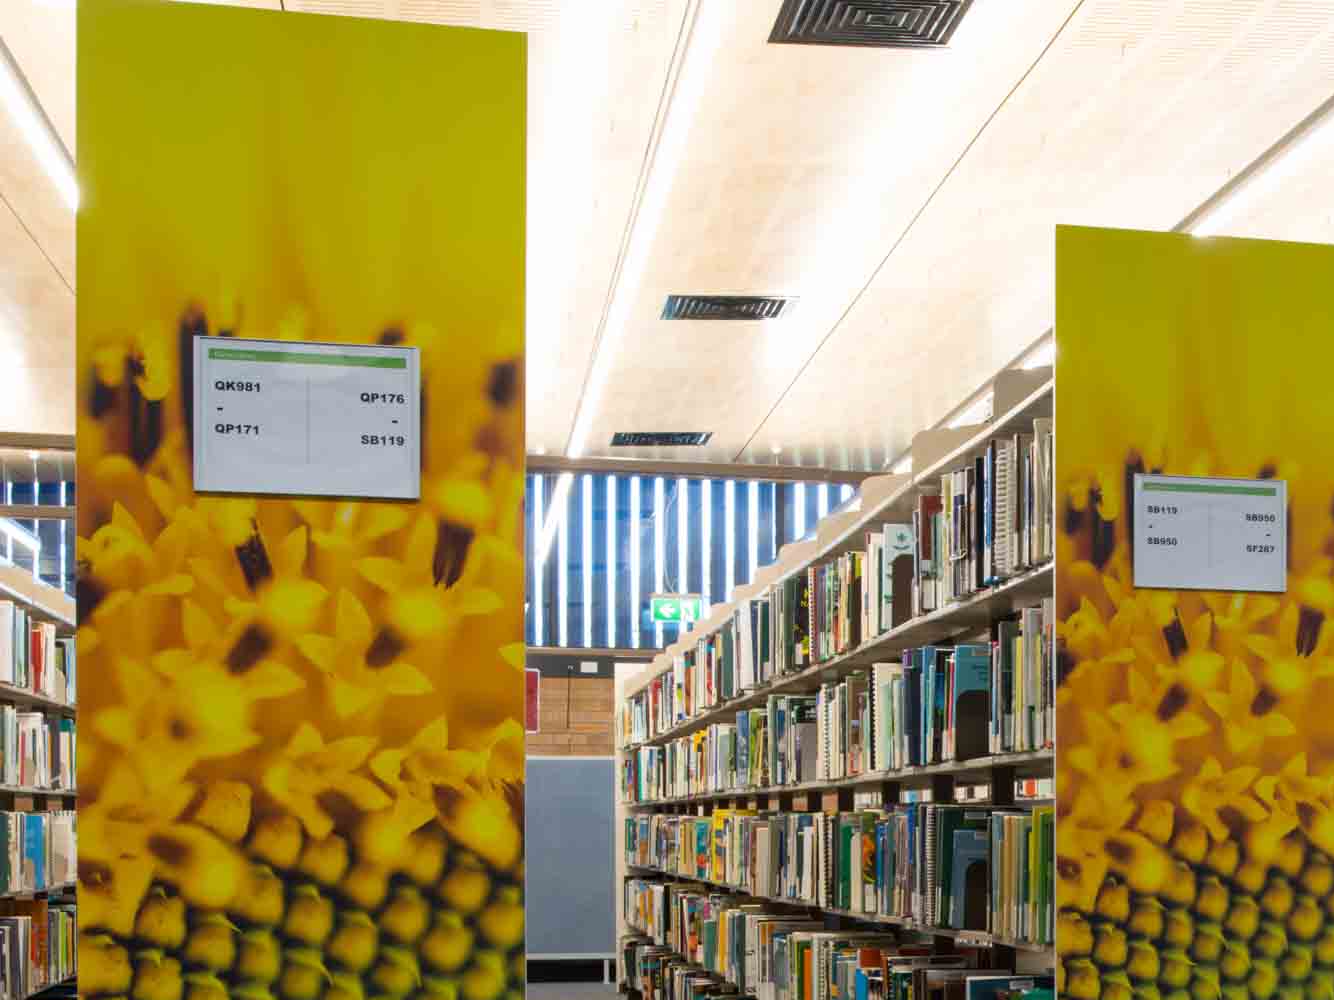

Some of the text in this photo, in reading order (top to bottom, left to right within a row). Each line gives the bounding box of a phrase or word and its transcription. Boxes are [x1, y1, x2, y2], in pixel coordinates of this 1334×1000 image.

[214, 380, 261, 393] QK981
[360, 392, 405, 405] QP176
[214, 423, 259, 435] QP171
[360, 434, 405, 447] SB119
